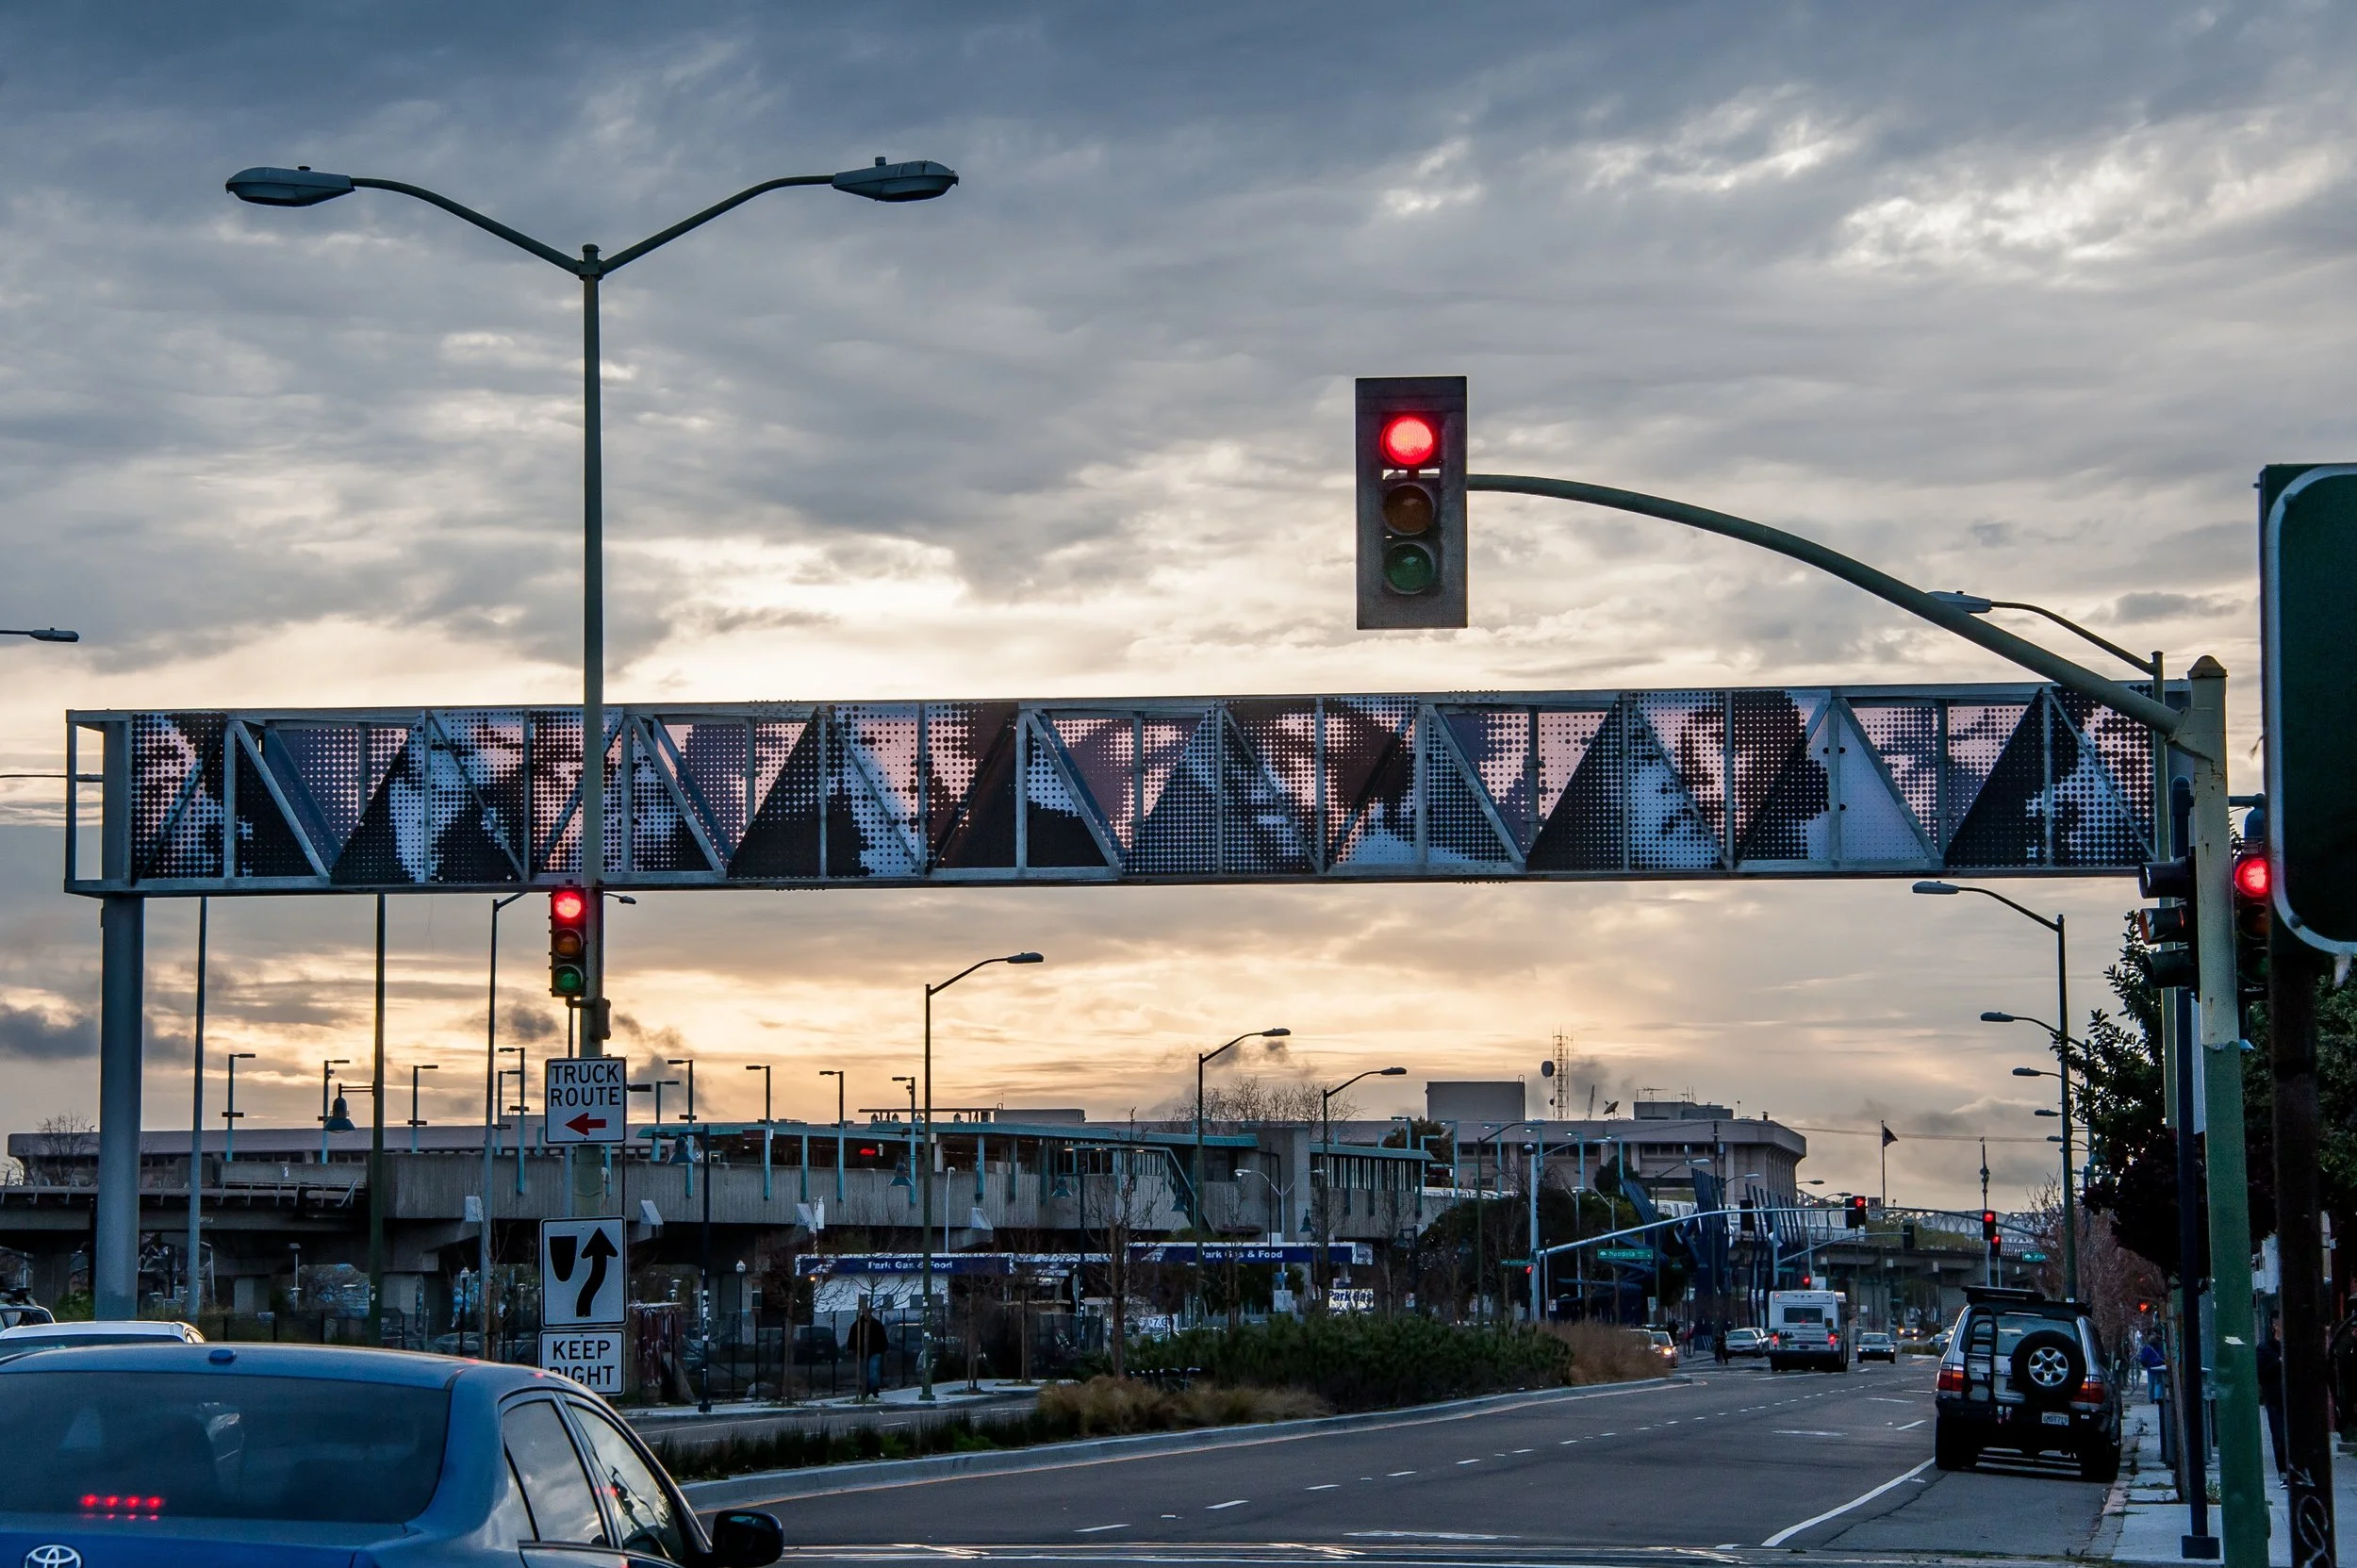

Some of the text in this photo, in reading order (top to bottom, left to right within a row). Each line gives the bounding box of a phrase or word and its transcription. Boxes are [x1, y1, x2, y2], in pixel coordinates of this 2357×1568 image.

[552, 1064, 619, 1084] TRUCK
[550, 1086, 621, 1107] ROUTE
[1202, 1250, 1223, 1259] ark
[552, 1340, 611, 1361] KEEP
